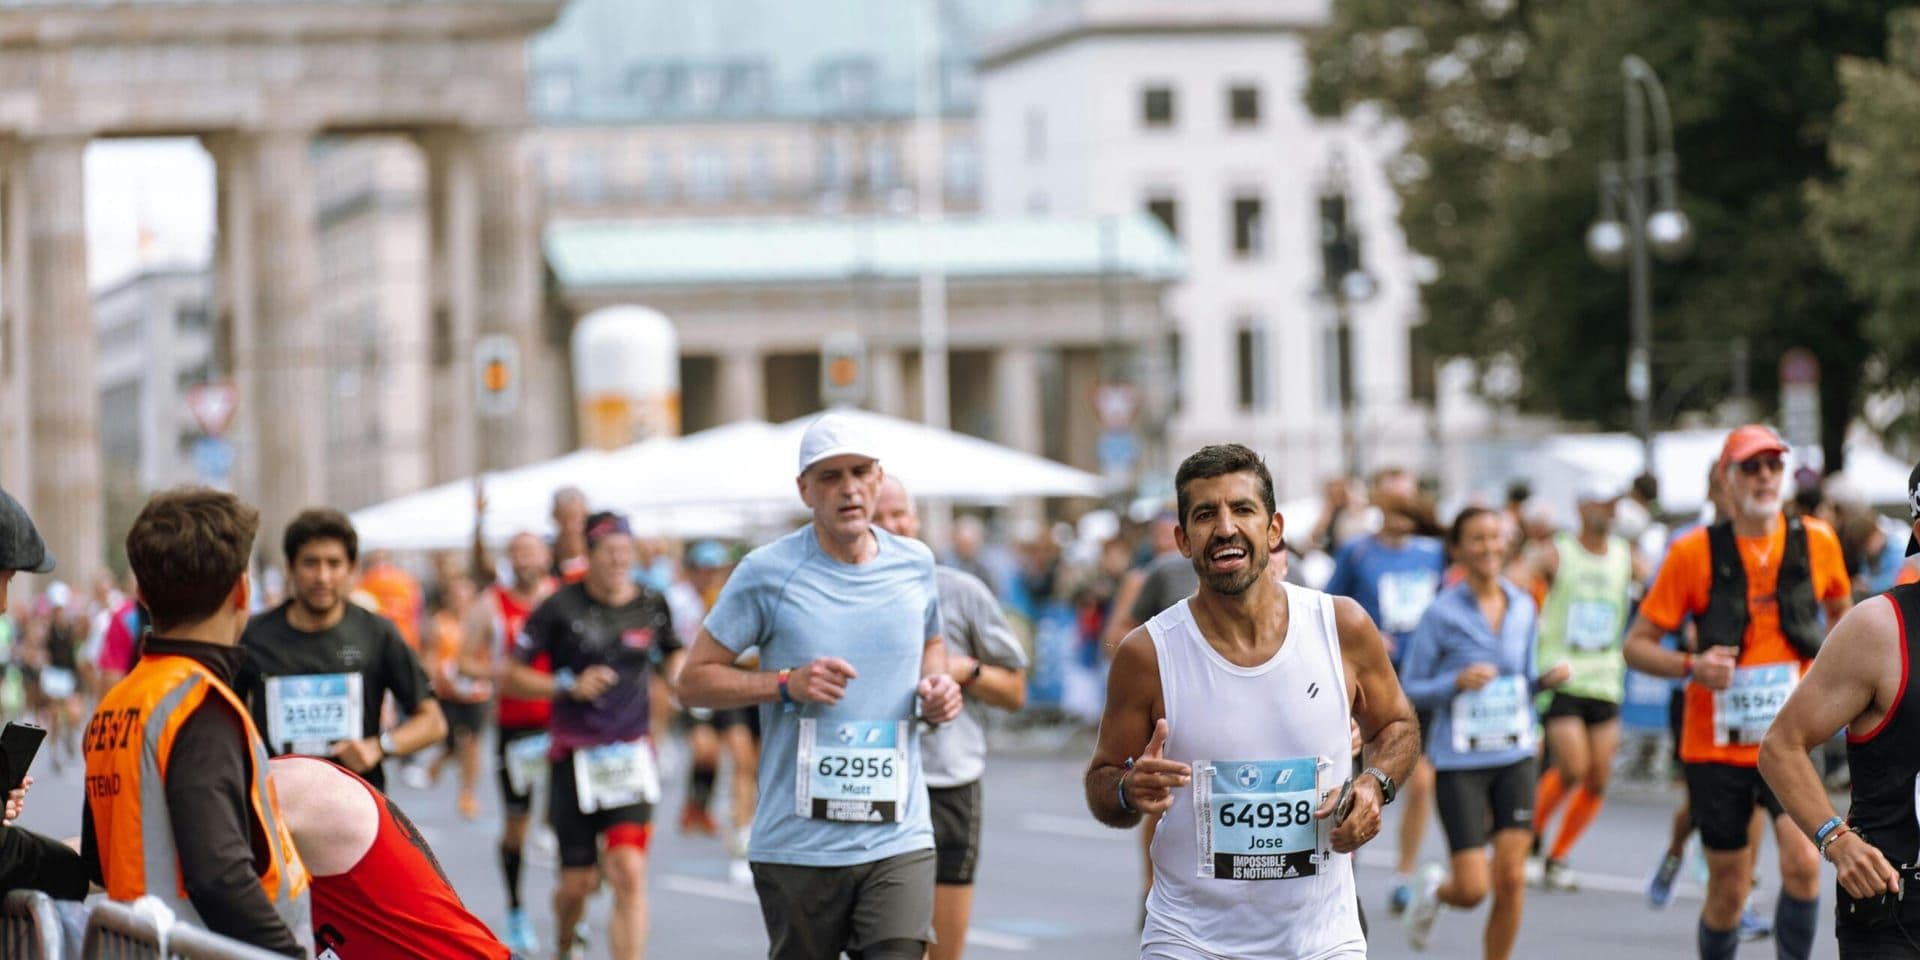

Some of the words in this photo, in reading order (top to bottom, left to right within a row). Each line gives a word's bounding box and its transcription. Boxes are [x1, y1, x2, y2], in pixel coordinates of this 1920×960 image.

[819, 757, 893, 778] 62956
[841, 783, 872, 795] Matt
[1219, 800, 1311, 828] 64938
[1248, 835, 1283, 850] Jose
[1233, 855, 1286, 867] IMPOSSIBLE
[1233, 867, 1242, 878] IS
[1243, 866, 1283, 878] NOTHING
